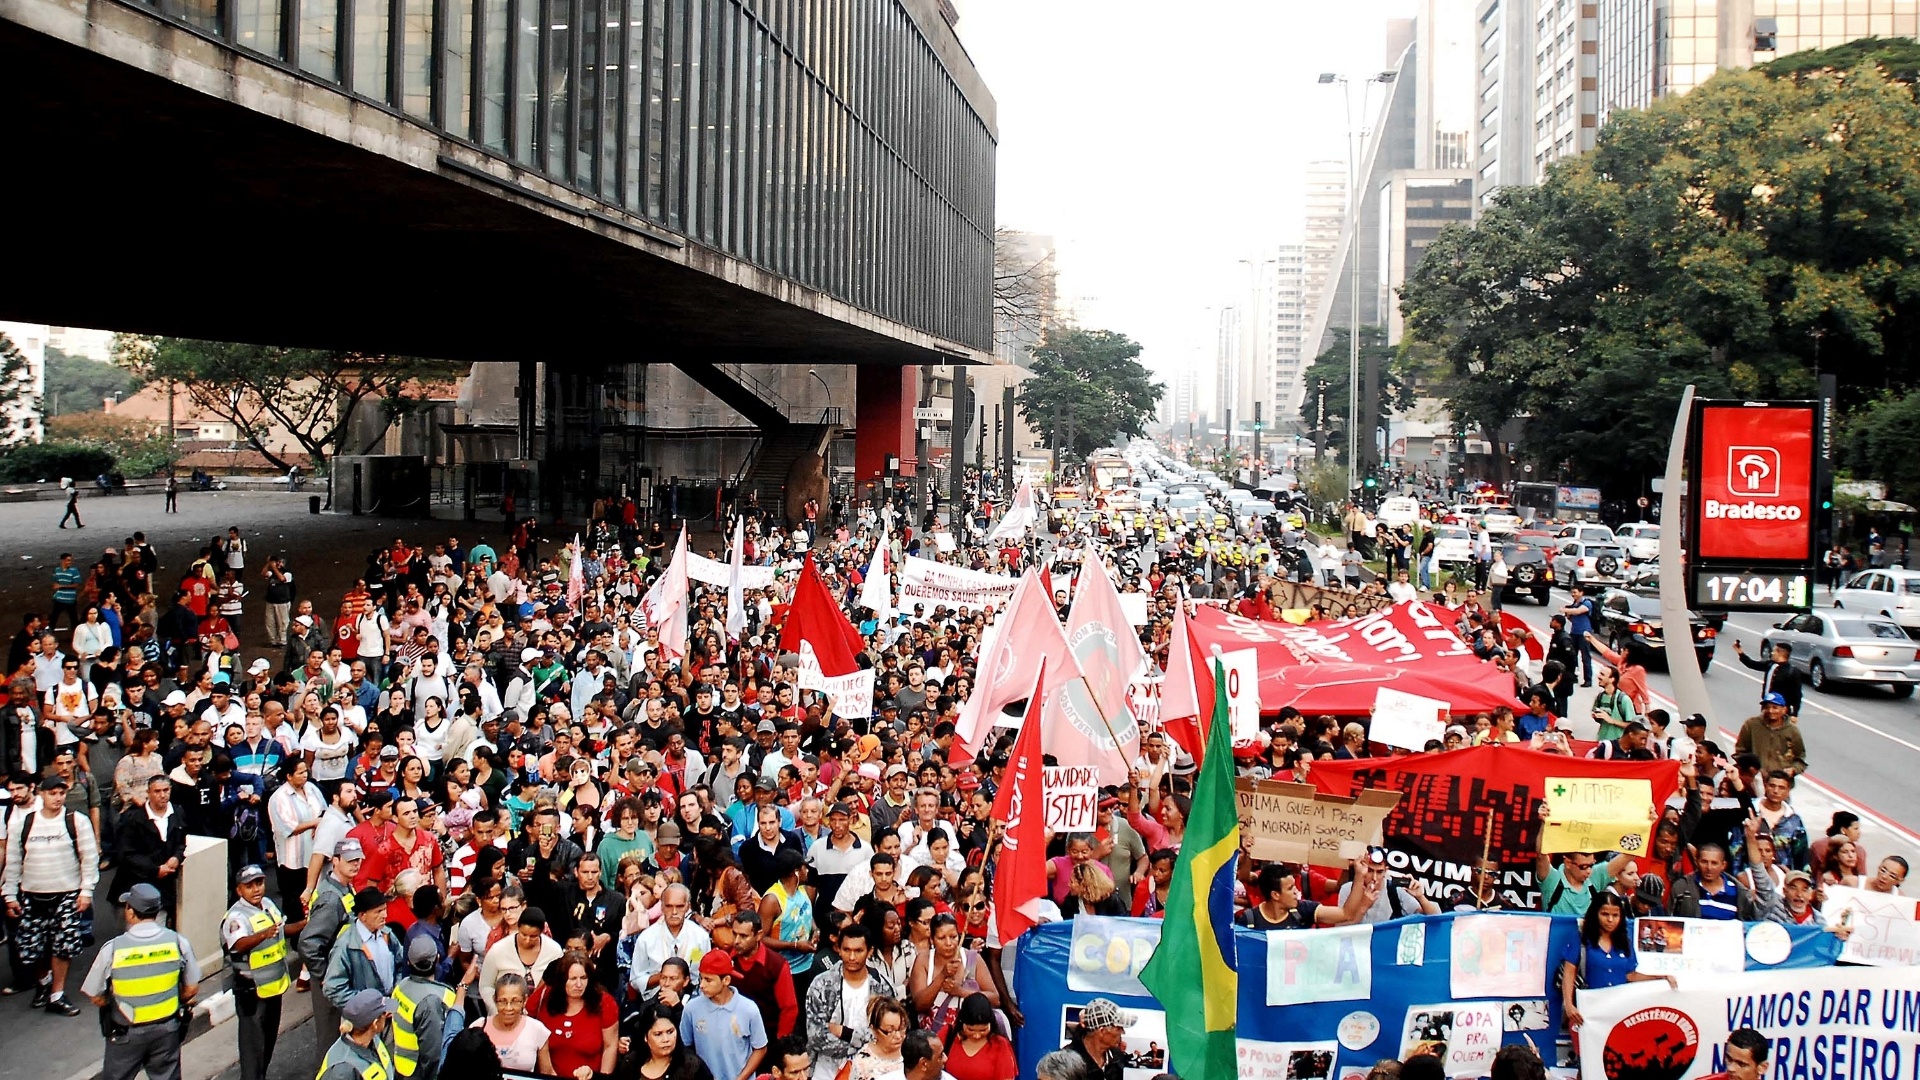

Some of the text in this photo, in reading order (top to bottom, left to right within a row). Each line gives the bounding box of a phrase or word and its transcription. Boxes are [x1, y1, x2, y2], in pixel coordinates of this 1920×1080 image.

[1705, 500, 1801, 520] Bradesco
[904, 583, 949, 601] QUEREMOS
[1707, 576, 1782, 602] 17:04
[1286, 801, 1326, 818] QUEM
[1331, 808, 1364, 826] PAGA
[1455, 1010, 1493, 1028] COPA
[1727, 989, 1920, 1033] VAMOS DAR UM
[1466, 1032, 1488, 1046] PRA
